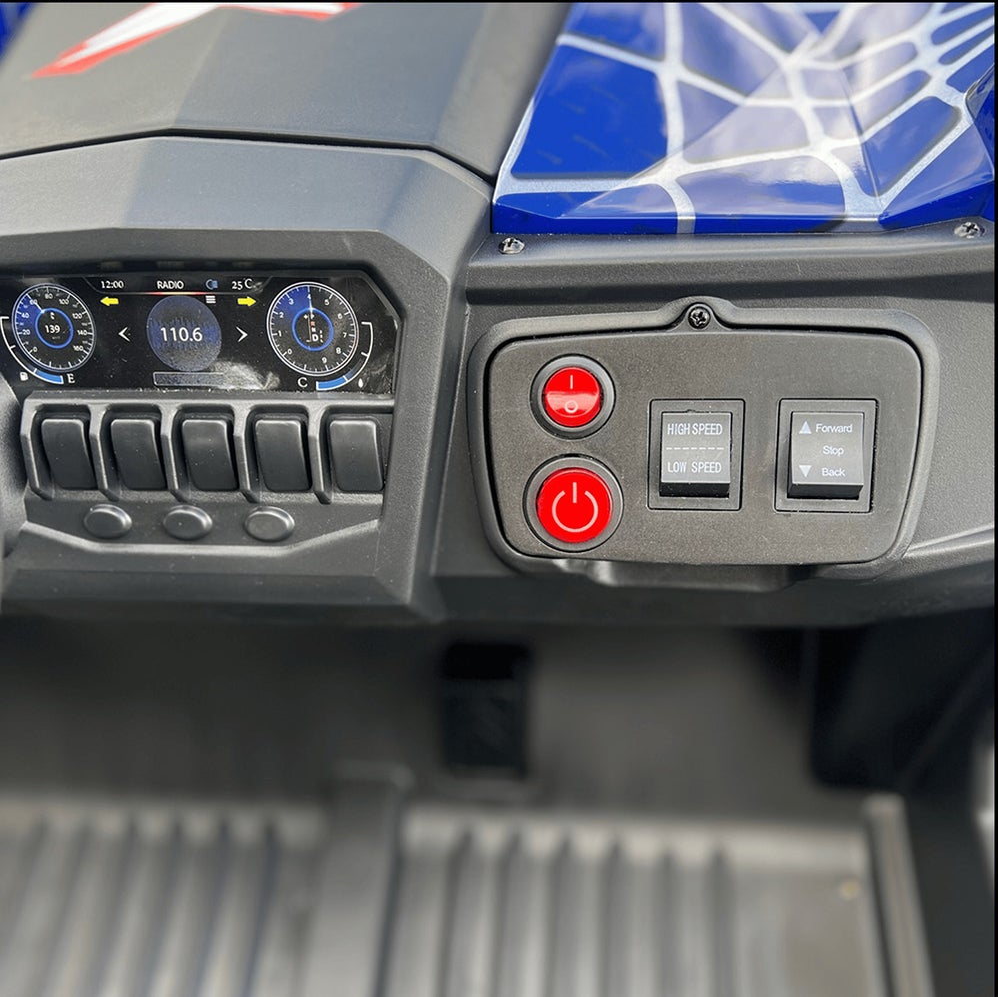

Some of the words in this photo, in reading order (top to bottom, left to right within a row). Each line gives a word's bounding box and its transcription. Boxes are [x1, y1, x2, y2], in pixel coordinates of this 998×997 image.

[101, 280, 124, 289] 12:00
[156, 280, 185, 290] RADIO
[231, 280, 243, 291] 25
[44, 324, 61, 334] 139
[160, 326, 203, 342] 110.6
[311, 333, 319, 342] D
[67, 373, 76, 384] E
[297, 377, 308, 388] C
[667, 423, 690, 435] HIGH
[692, 423, 723, 435] SPEED
[815, 423, 853, 433] Forward
[823, 445, 844, 457] Stop
[667, 461, 687, 473] LOW
[691, 461, 722, 473] SPEED
[821, 467, 846, 477] Back
